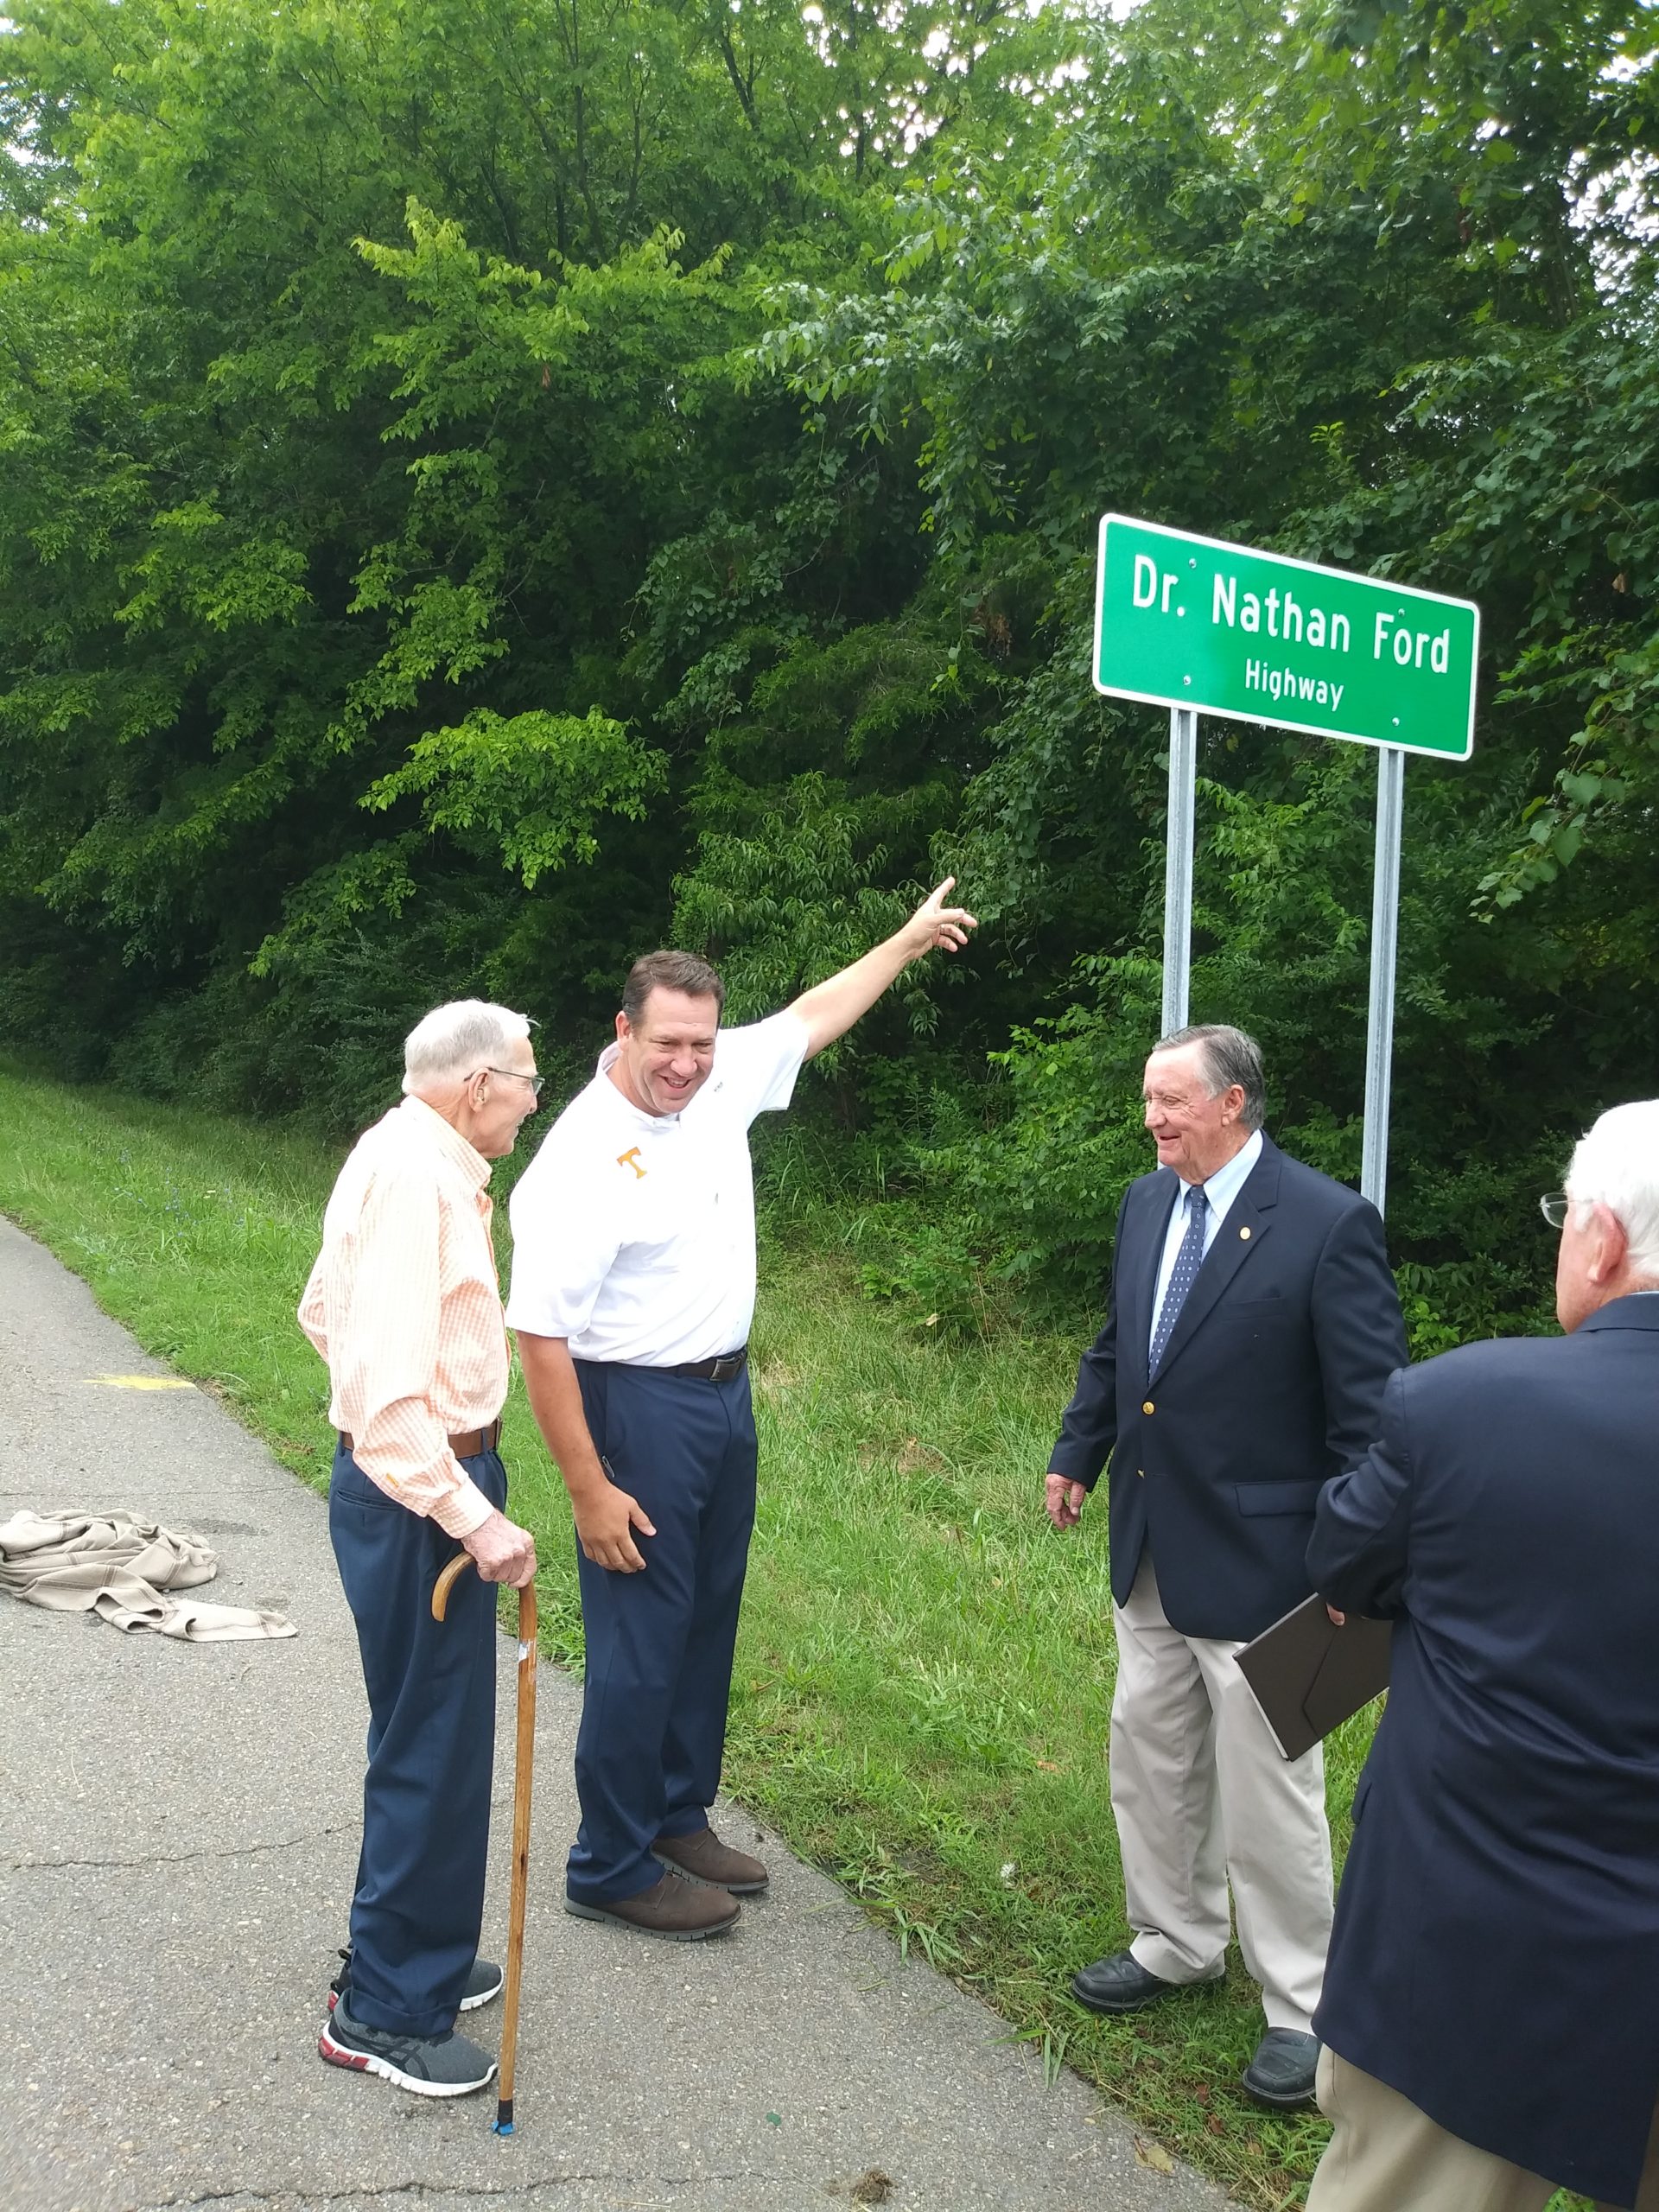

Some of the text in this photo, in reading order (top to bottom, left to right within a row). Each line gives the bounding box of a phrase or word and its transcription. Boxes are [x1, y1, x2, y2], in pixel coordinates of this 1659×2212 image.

[1133, 554, 1450, 673] Dr. Nathan Ford
[1245, 658, 1344, 711] Highway
[616, 1147, 648, 1179] T
